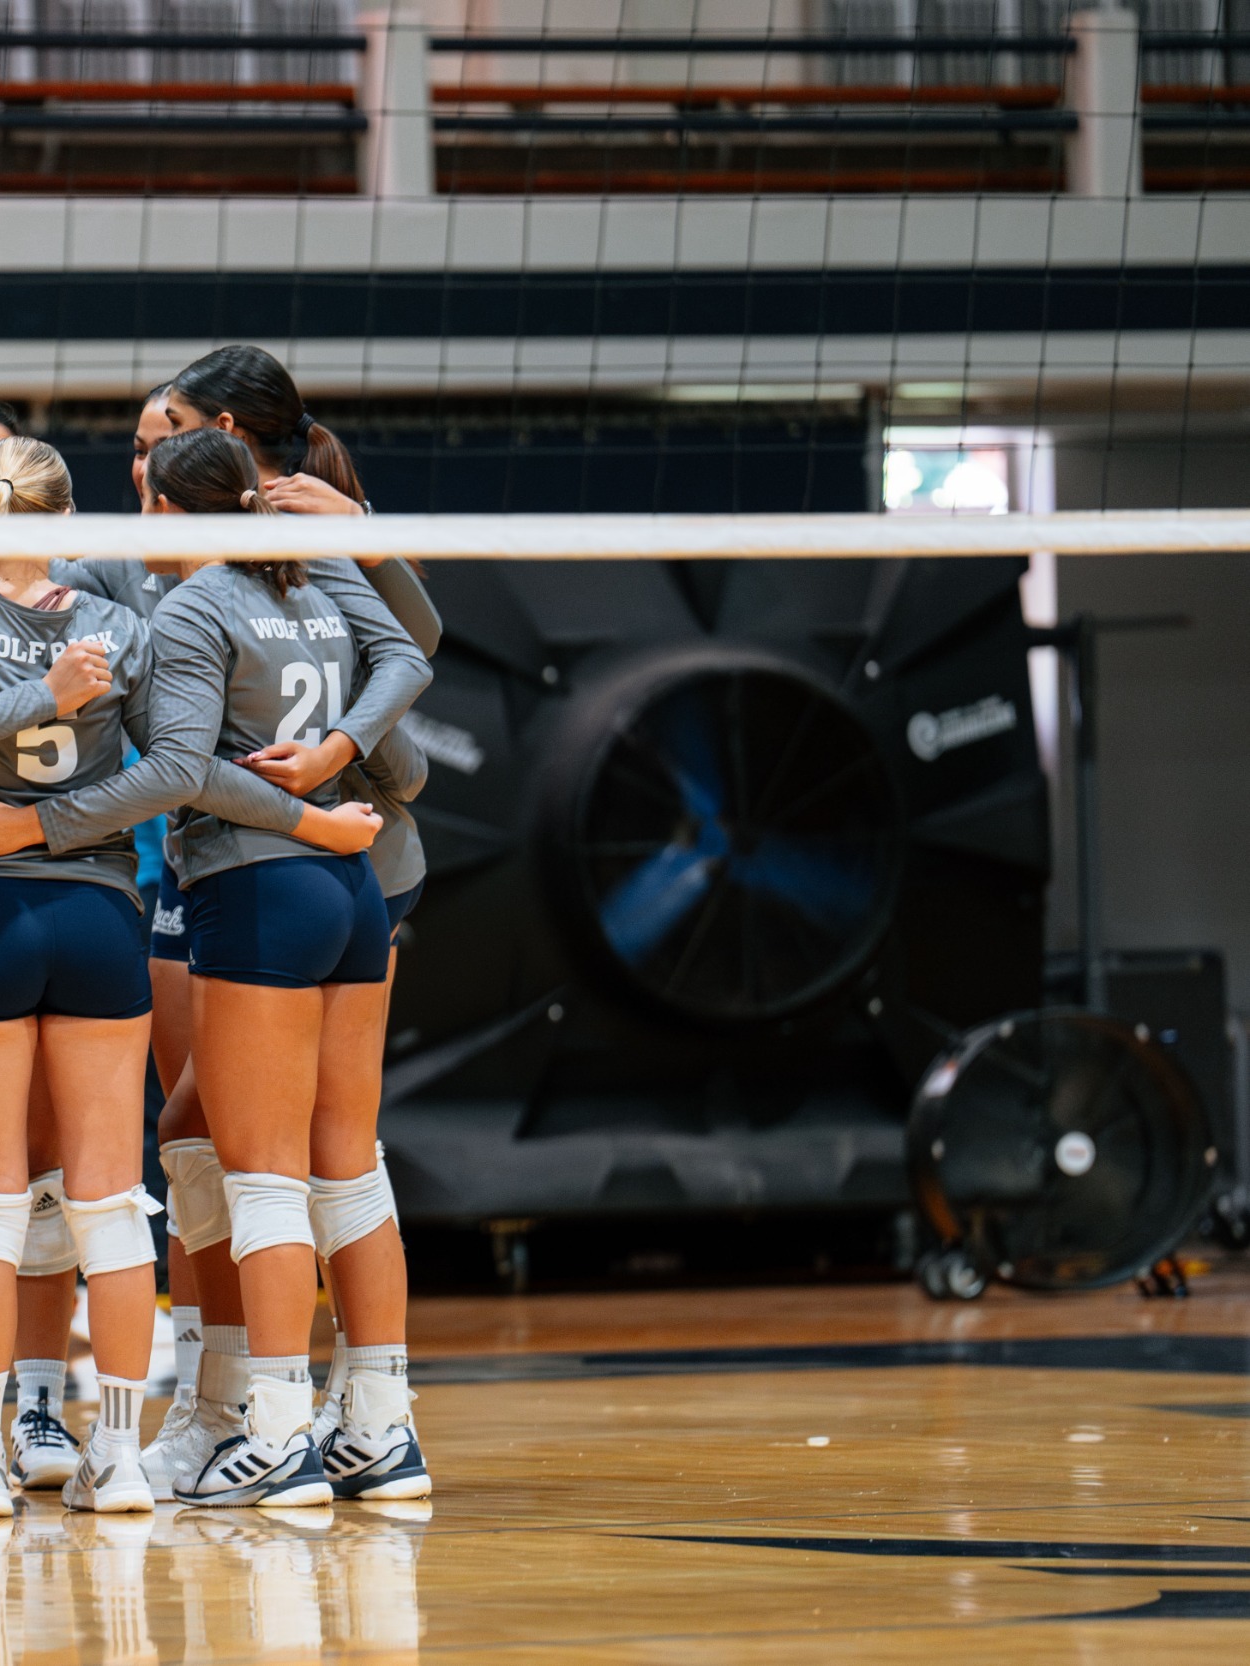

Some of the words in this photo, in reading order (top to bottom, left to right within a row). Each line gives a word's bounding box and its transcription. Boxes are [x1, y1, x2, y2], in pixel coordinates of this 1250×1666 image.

[50, 630, 120, 665] PK
[249, 617, 300, 640] WOLF
[275, 661, 342, 749] 21
[16, 711, 78, 783] 5
